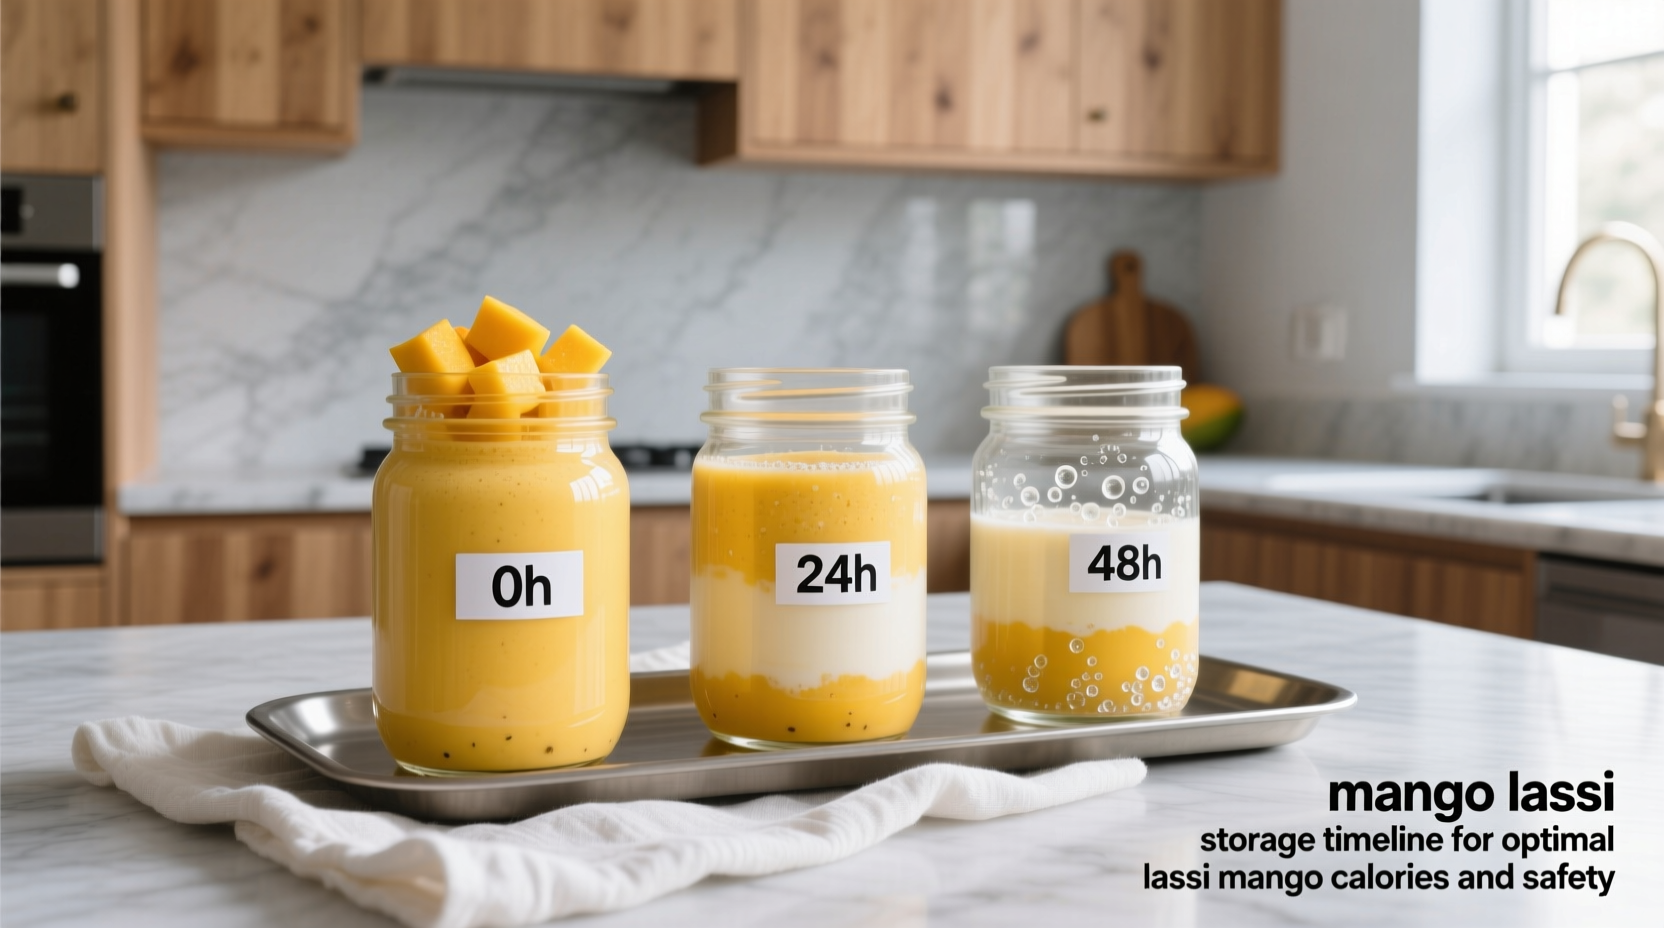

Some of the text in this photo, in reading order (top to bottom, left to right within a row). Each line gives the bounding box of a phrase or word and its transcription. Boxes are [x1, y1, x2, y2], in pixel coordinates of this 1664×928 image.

[796, 553, 877, 594] 24h
[1087, 544, 1162, 582] 48h
[491, 564, 552, 608] 0h
